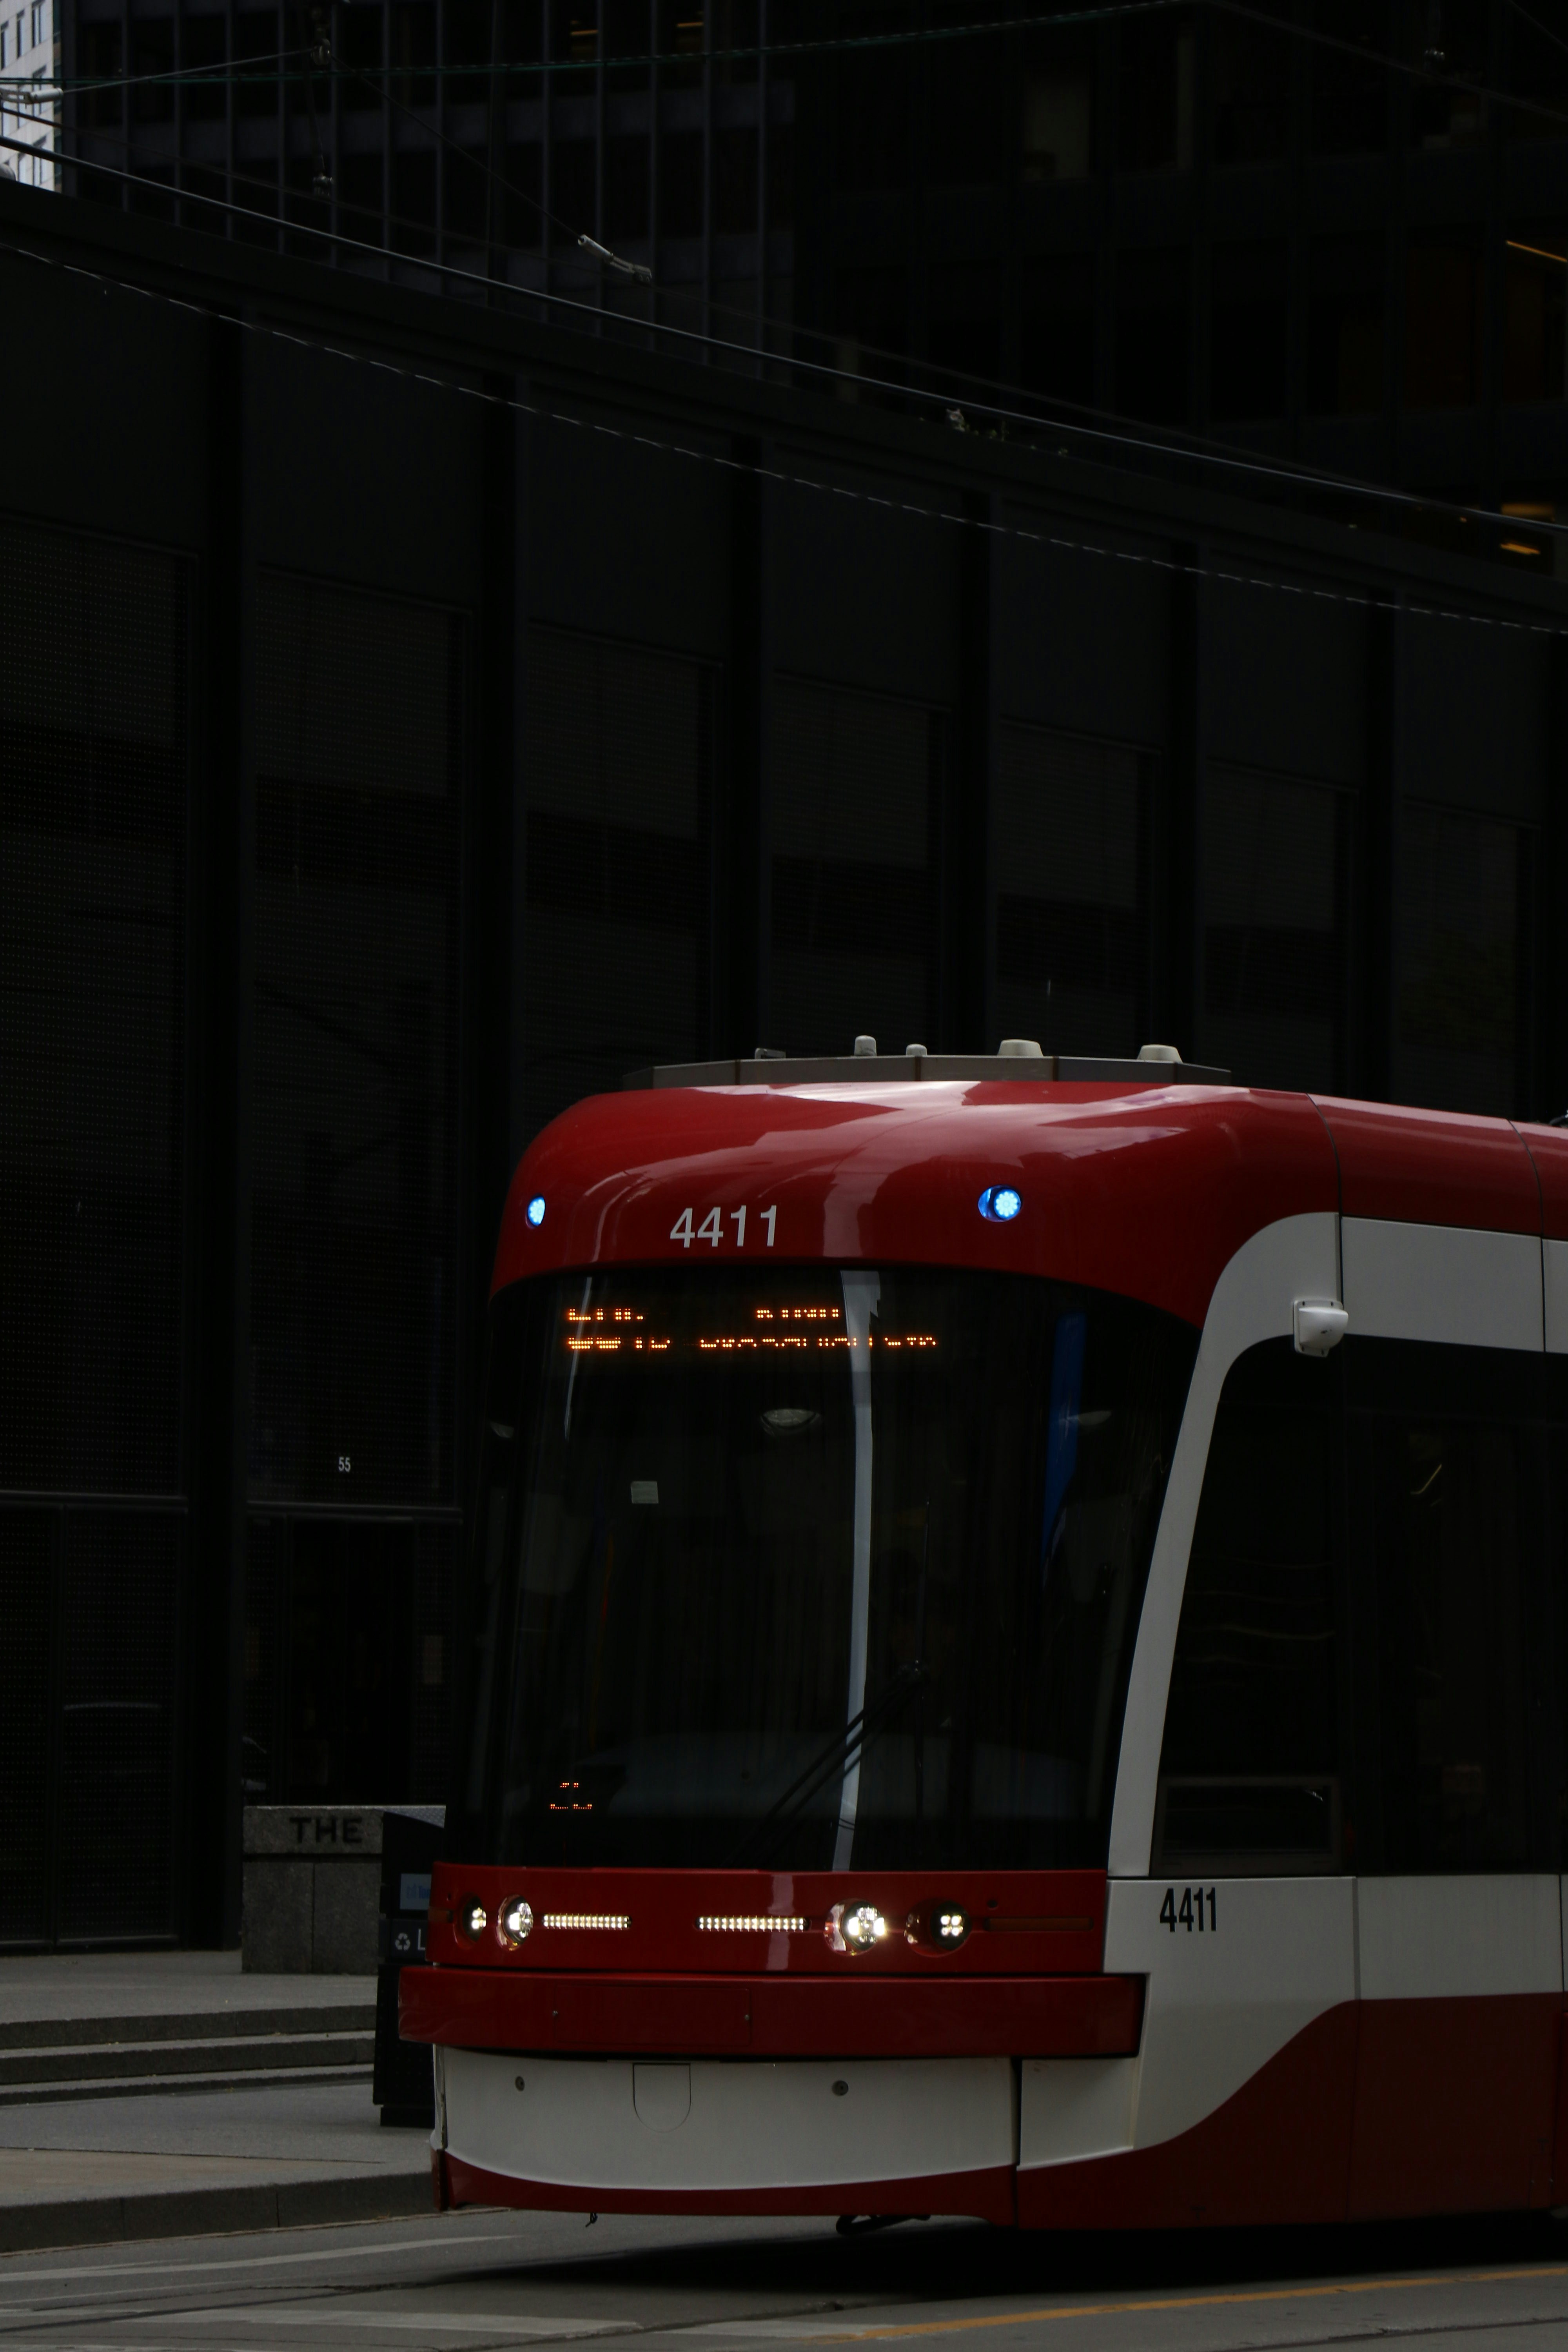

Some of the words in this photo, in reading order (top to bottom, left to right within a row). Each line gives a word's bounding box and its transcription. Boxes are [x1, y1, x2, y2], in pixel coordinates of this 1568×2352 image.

[670, 1204, 777, 1248] 4411
[338, 1456, 351, 1473] 55
[289, 1817, 362, 1842] THE
[1160, 1887, 1216, 1932] 4411
